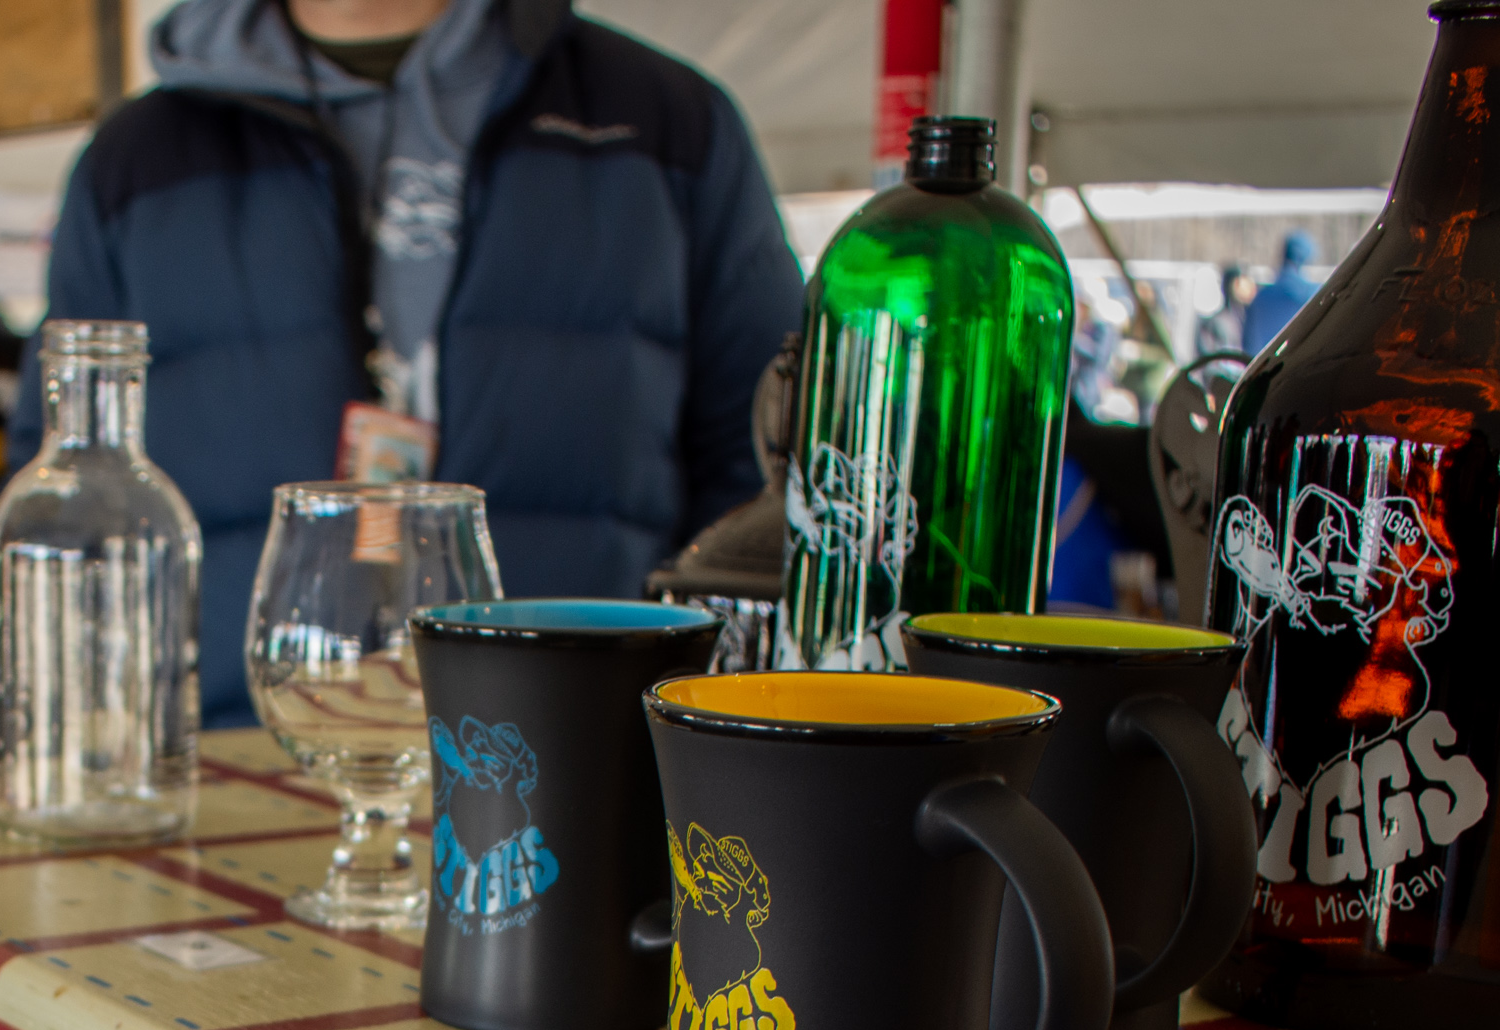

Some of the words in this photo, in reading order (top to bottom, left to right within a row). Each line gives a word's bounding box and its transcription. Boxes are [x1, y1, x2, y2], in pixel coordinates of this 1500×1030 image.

[1368, 503, 1421, 546] IGGS
[720, 839, 750, 868] STIGGS
[1252, 881, 1294, 928] ity,
[1315, 865, 1447, 928] Michigan
[480, 902, 541, 936] Michigan
